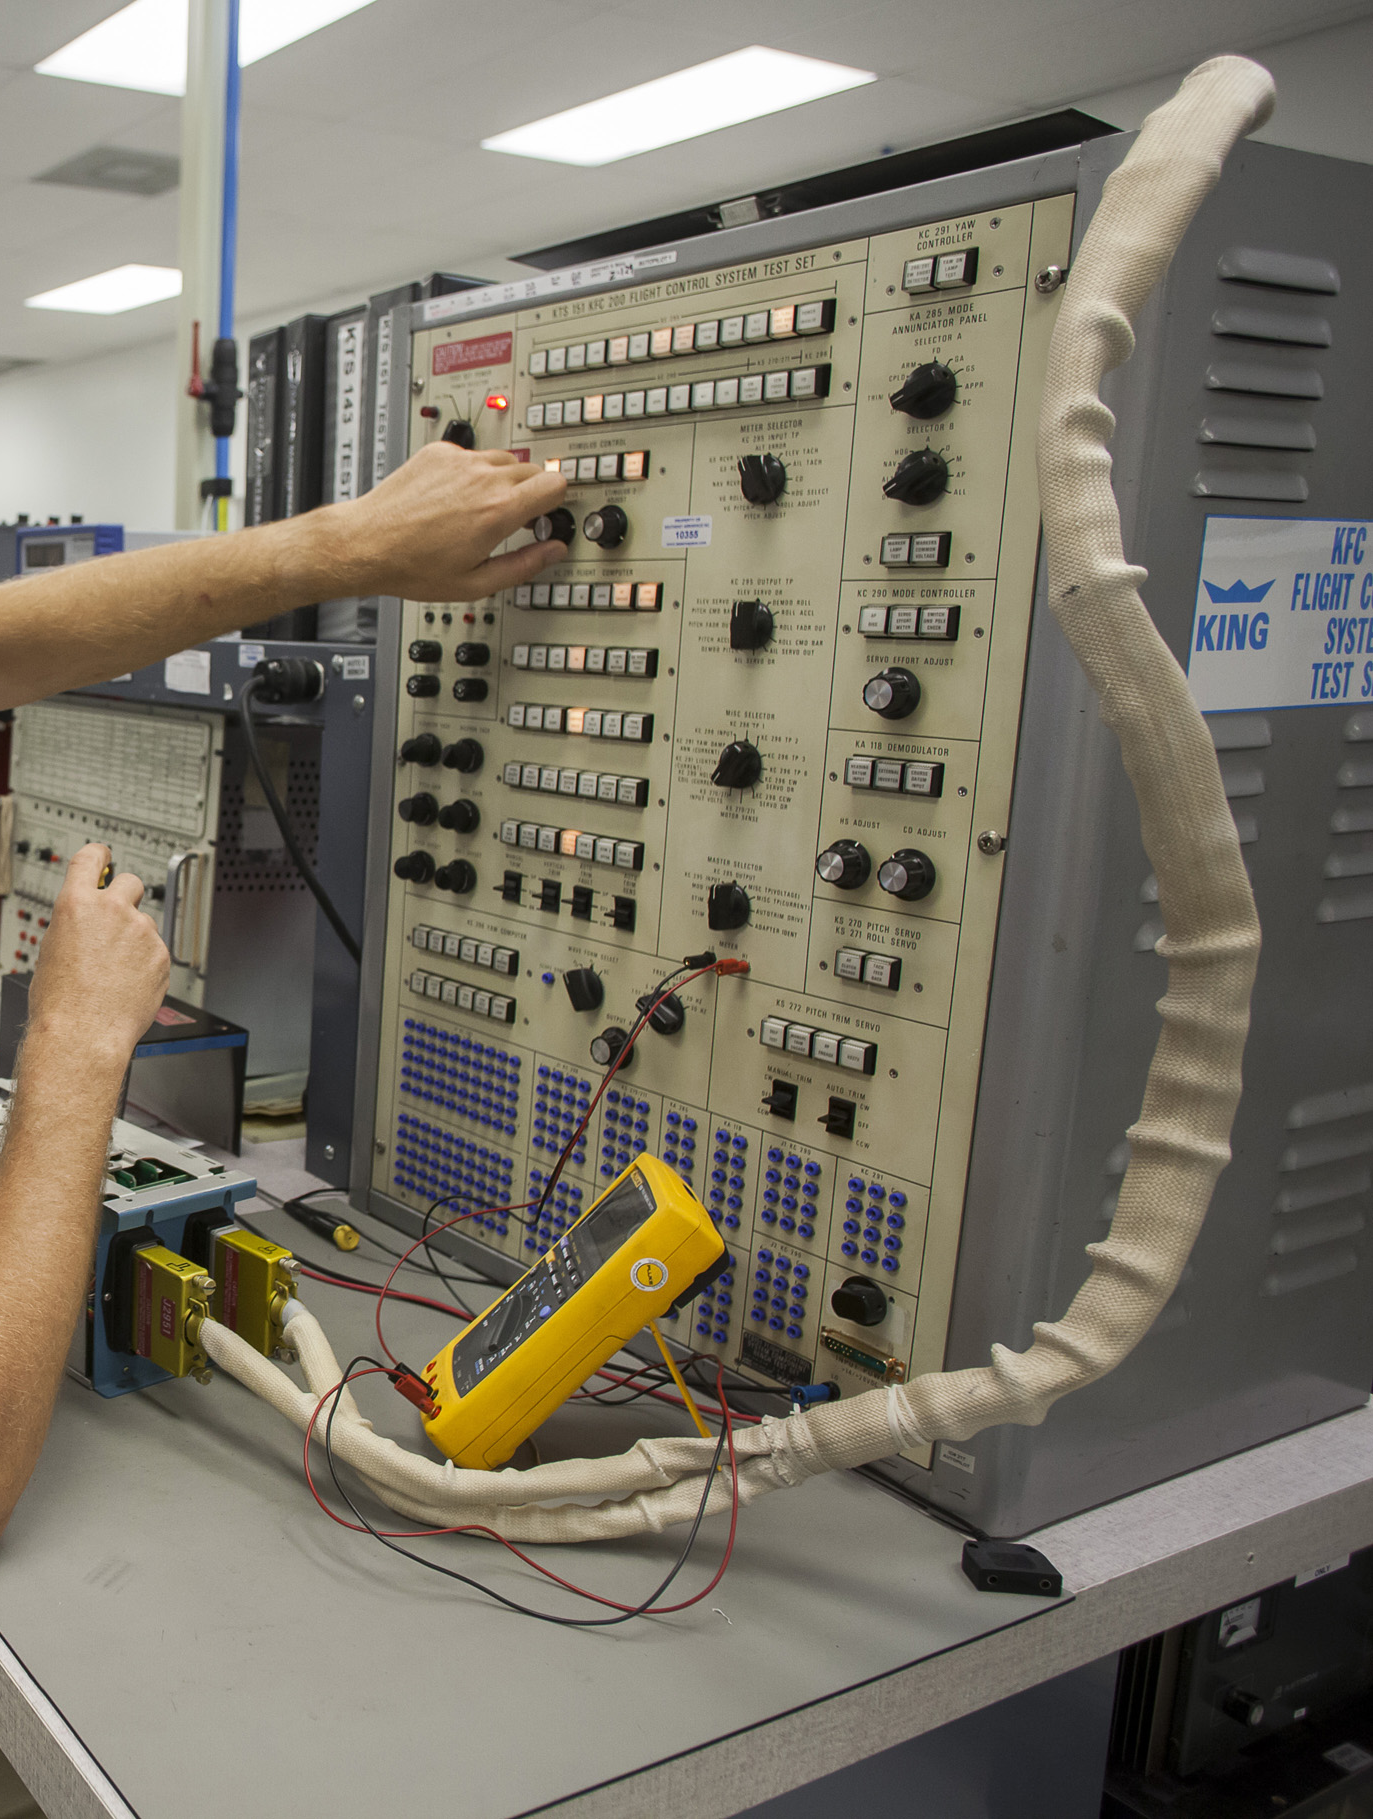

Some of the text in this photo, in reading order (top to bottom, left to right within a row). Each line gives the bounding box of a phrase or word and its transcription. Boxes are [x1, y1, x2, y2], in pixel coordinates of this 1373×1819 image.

[919, 220, 976, 239] KC 291 YAW
[917, 232, 973, 251] CONTROLLER
[552, 254, 817, 318] KTS 151 KFC 200 FLIGHT CONTROL SYSTEM TEST SET
[909, 303, 974, 321] KA 285 MODE
[892, 313, 988, 335] ANNUNCIATOR PANEL
[914, 336, 952, 346] SELECTOR
[888, 374, 905, 382] CPLD
[964, 381, 984, 389] APPR
[340, 327, 356, 500] KTS 143 TEST
[740, 419, 803, 433] METER SELECTOR
[907, 423, 945, 434] SELECTOR
[768, 433, 787, 441] INPUT
[807, 488, 829, 496] SELECT
[676, 531, 699, 539] 10355
[1331, 527, 1367, 565] KFC
[602, 568, 633, 576] COMPUTER
[857, 589, 976, 599] KC 290 MODE CONTROLLER
[1291, 573, 1373, 611] FLIGHT C
[1195, 612, 1270, 652] KING
[866, 655, 954, 666] SERVO EFFORT ADJUST
[1310, 660, 1373, 700] TEST S
[726, 710, 775, 720] MISC SELECTOR
[855, 740, 950, 757] KA 118 DEMODULATOR
[853, 819, 881, 829] ADJUST
[917, 828, 947, 839] ADJUST
[707, 856, 763, 871] MASTER SELECTOR
[736, 871, 756, 881] OUTPUT
[754, 924, 798, 938] ADAPTER IDENT
[834, 916, 922, 940] KS 270 PITCH SERVO
[719, 941, 738, 950] METER
[835, 927, 917, 950] KS 271 ROLL SERVO
[776, 999, 881, 1033] KS 272 PITCH TRIM SERVO
[767, 1065, 812, 1084] MANUAL TRIM
[826, 1083, 866, 1100] AUTO TRIM
[860, 1103, 870, 1111] CW
[855, 1140, 870, 1149] CCW
[163, 1298, 172, 1335] J2951
[1315, 1564, 1330, 1577] ONLY
